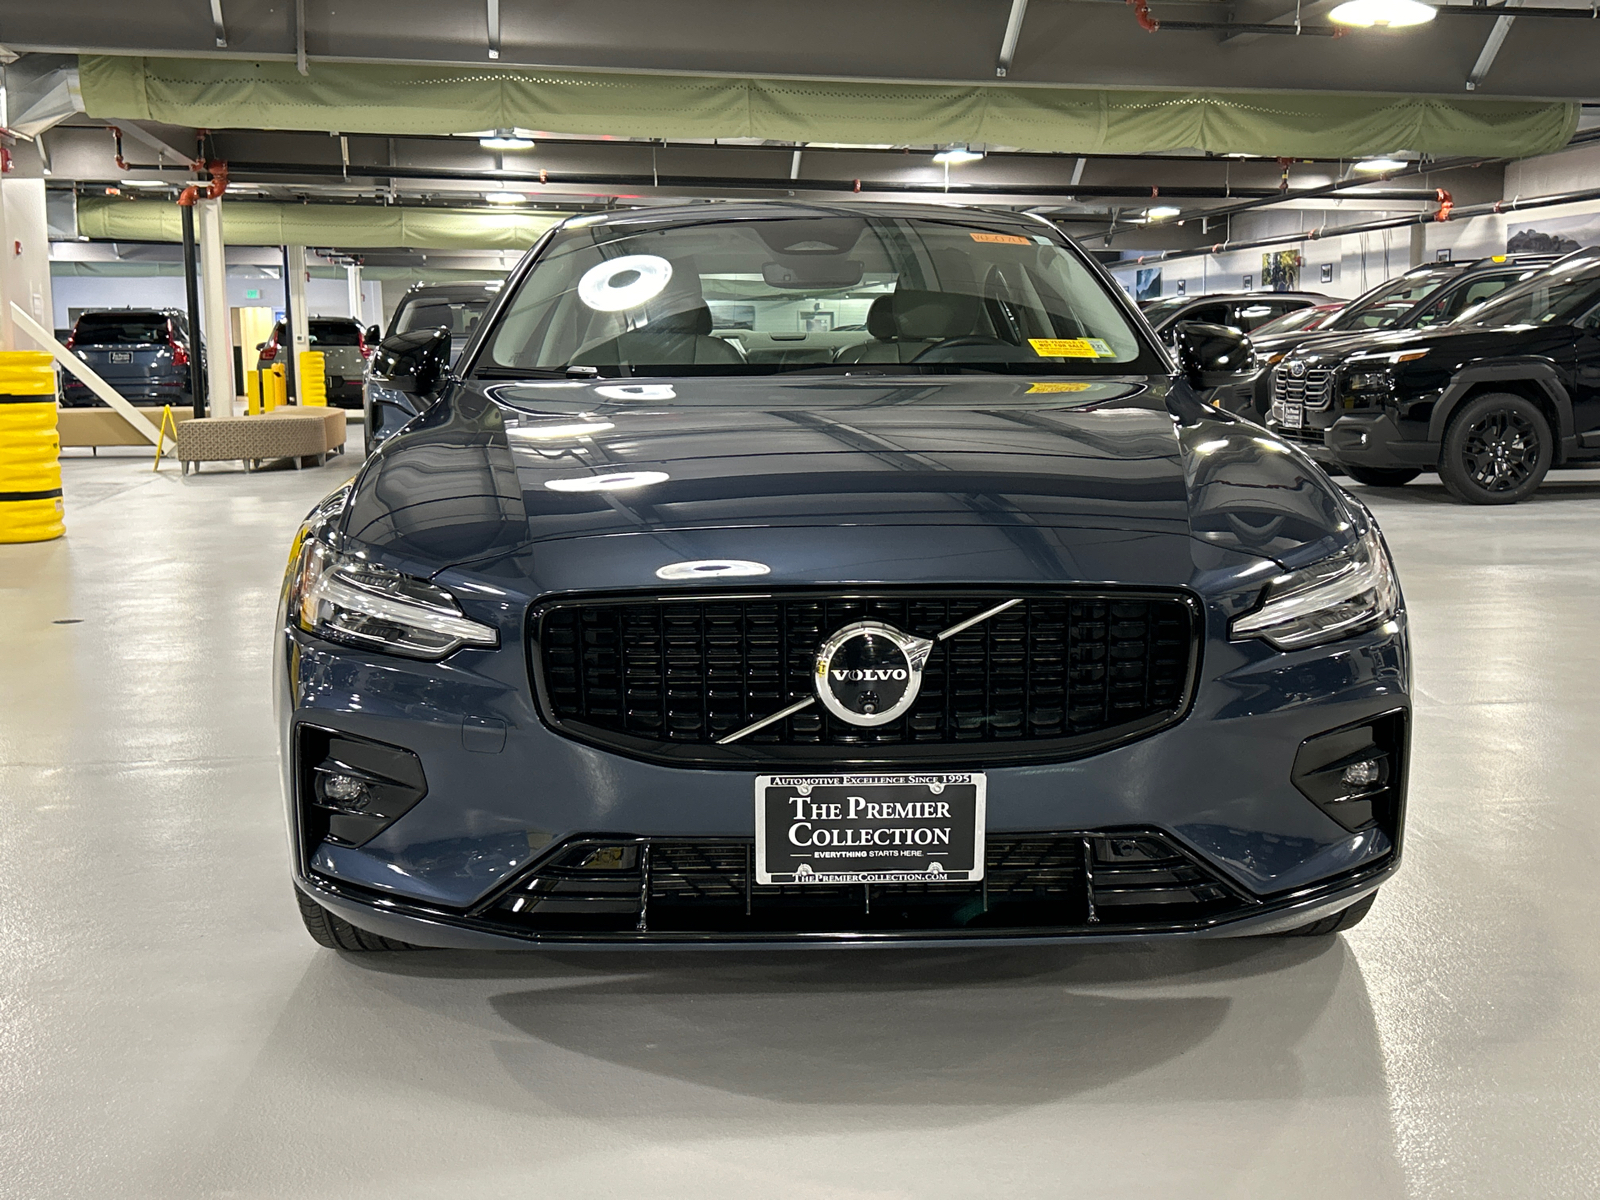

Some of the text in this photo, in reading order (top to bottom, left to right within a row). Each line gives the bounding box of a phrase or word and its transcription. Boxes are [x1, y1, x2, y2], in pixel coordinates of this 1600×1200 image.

[831, 669, 907, 681] VOLVO
[773, 775, 970, 786] AUTOMOTIVE EXCELLENCE SINCE 1995
[788, 796, 951, 820] THE PREMIER
[788, 821, 952, 847] COLLECTION
[814, 850, 867, 859] EVERYTHING
